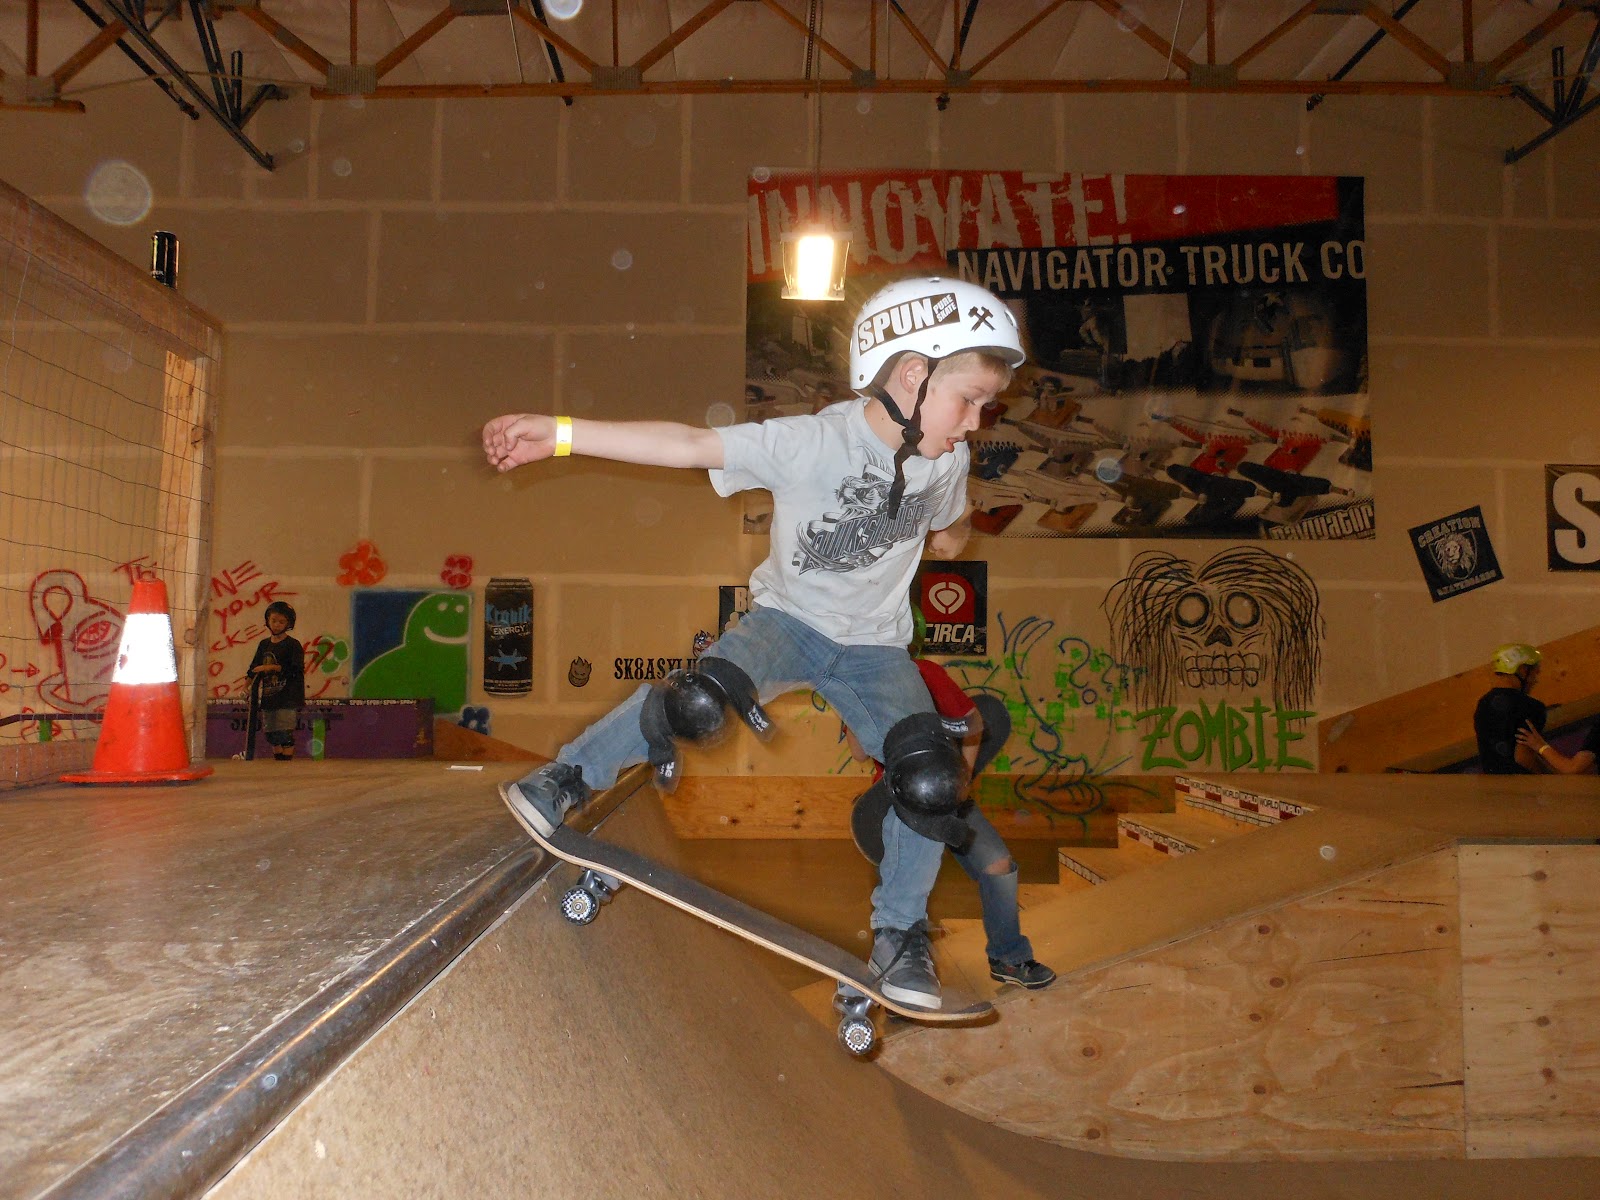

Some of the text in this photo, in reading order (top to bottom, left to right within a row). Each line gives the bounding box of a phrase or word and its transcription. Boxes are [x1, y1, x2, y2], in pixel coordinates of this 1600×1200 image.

[1179, 242, 1309, 286] TRUCK
[932, 294, 953, 315] PURE
[936, 301, 958, 323] SKATE
[858, 298, 935, 351] SPUN
[1417, 516, 1482, 549] CREATION
[213, 580, 300, 634] YOUR
[493, 625, 526, 637] ENERGY
[1136, 698, 1317, 772] ZOMBIE
[1259, 798, 1278, 810] WORLD
[1279, 802, 1301, 816] WORLD
